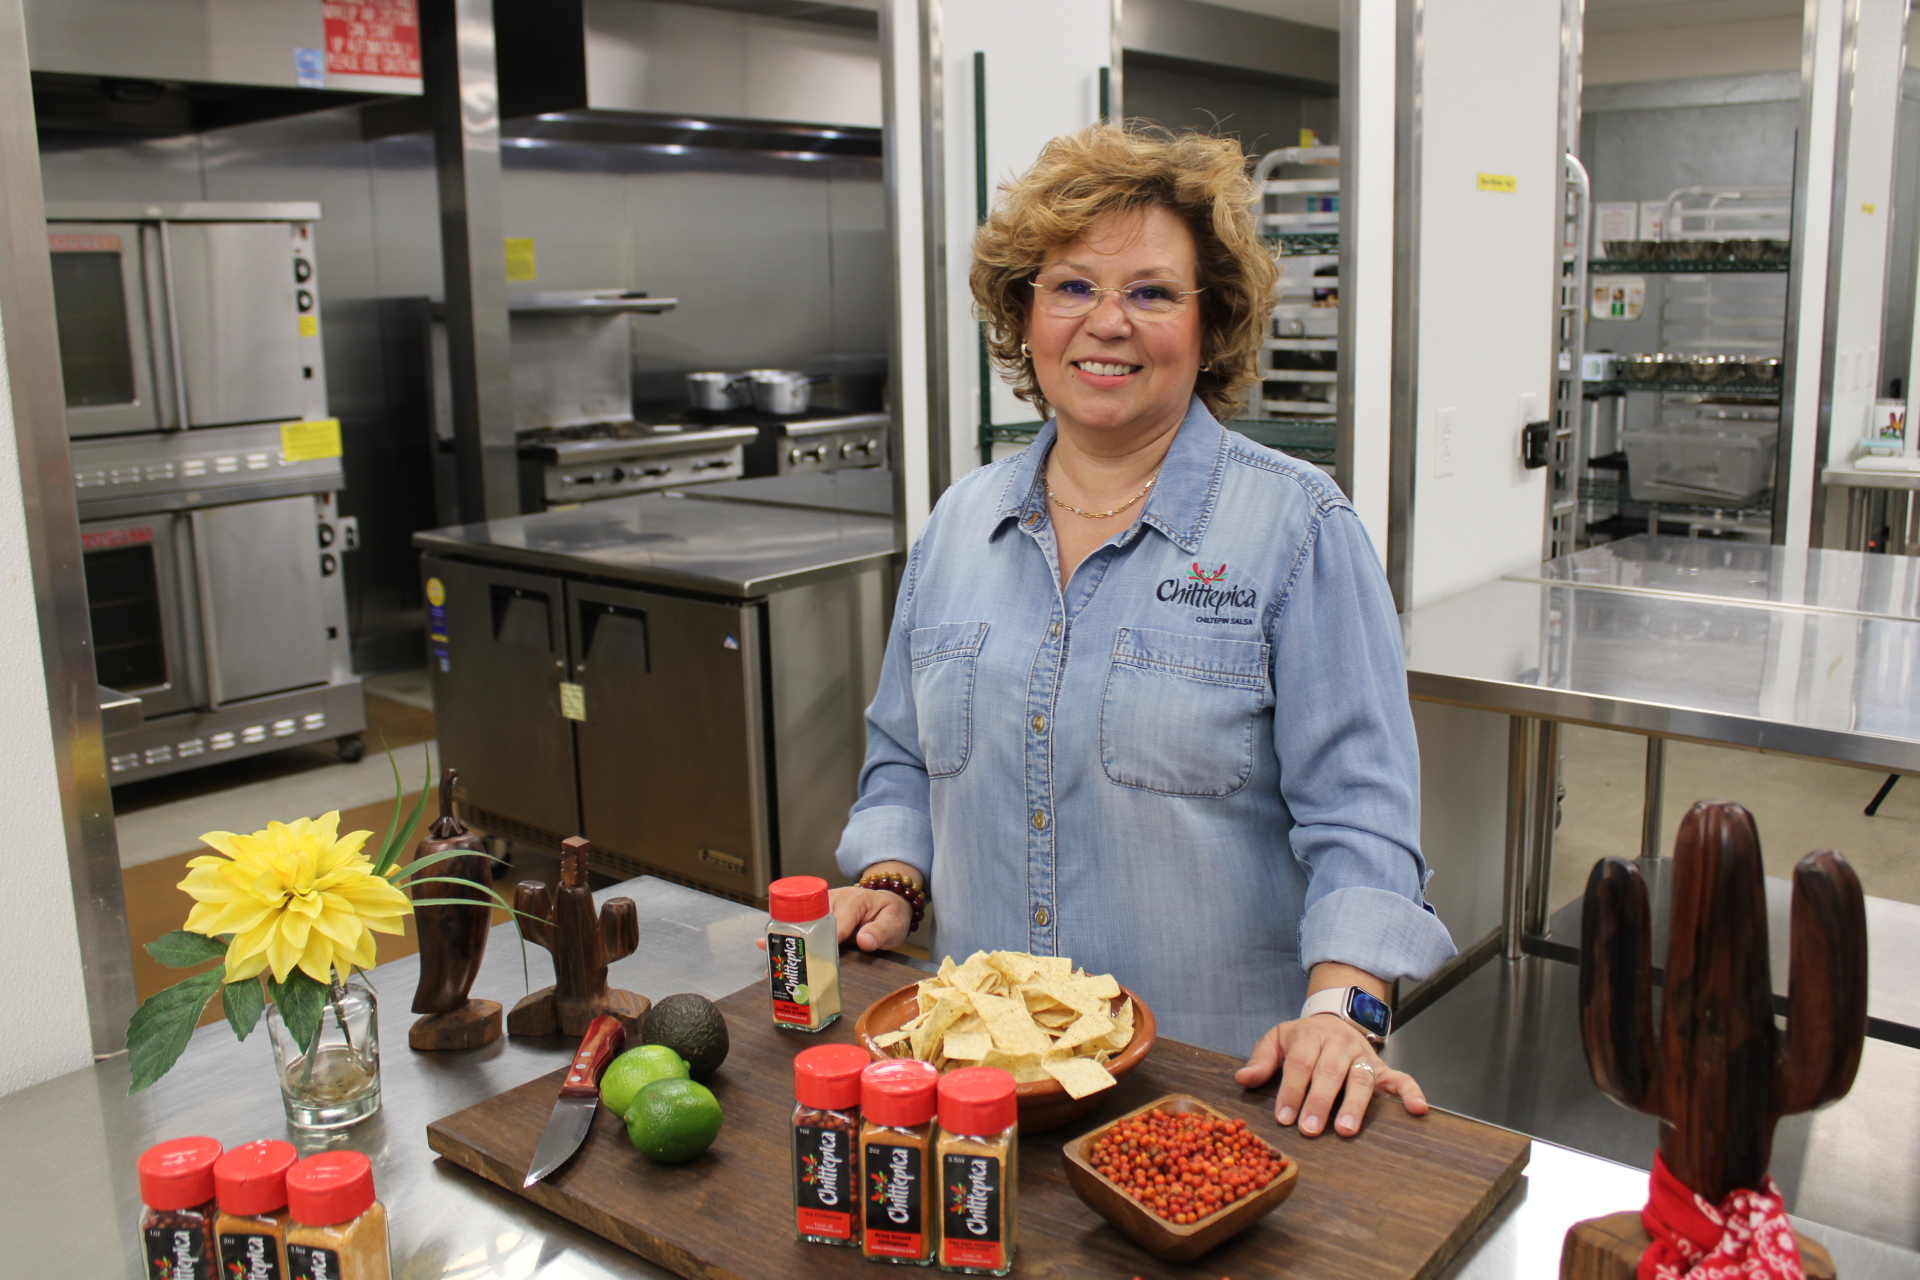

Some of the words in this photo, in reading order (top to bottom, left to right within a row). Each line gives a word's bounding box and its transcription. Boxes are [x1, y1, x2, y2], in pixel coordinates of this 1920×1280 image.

[1156, 578, 1257, 616] Chilttepica
[1230, 618, 1253, 626] SALSA
[784, 937, 802, 996] Chilttepica
[817, 1130, 843, 1206] Chilttepica
[887, 1147, 915, 1224] Chilttepica
[966, 1158, 994, 1236] Chilttepica
